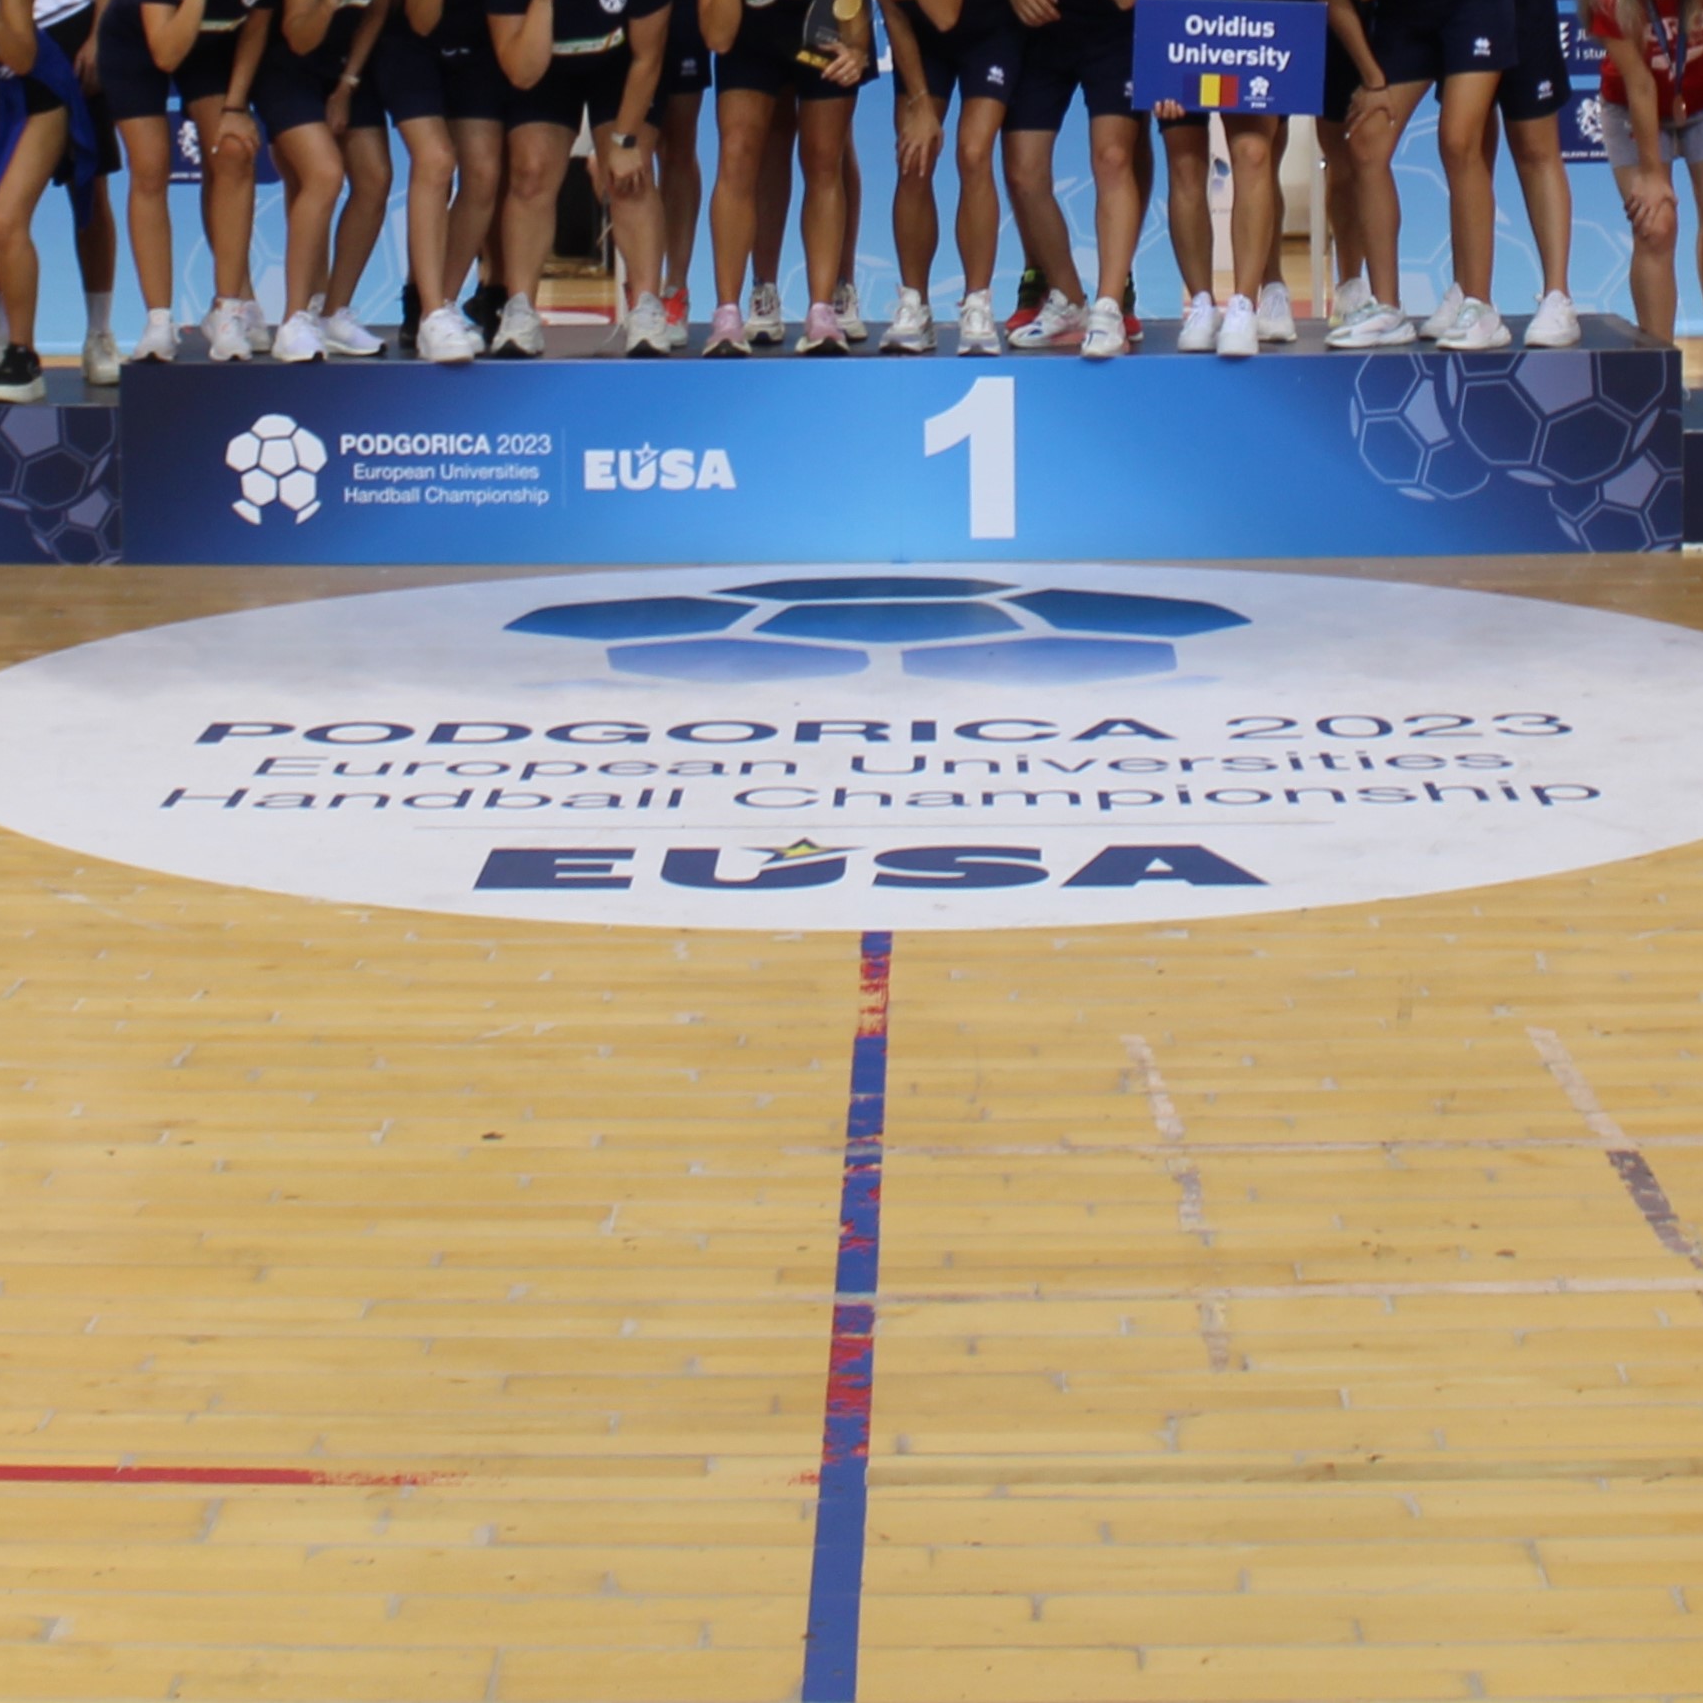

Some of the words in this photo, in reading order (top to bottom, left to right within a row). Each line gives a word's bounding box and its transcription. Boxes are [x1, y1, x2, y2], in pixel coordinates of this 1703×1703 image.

[1184, 14, 1275, 38] Ovidius
[1167, 42, 1291, 72] University
[340, 433, 492, 456] PODGORICA
[496, 433, 552, 455] 2023
[924, 376, 1016, 539] 1
[353, 463, 435, 482] European
[439, 462, 540, 480] Universities
[583, 441, 737, 491] EUSA
[343, 487, 420, 504] Handball
[424, 486, 550, 507] Championship
[195, 718, 1178, 745] PODGORICA
[1225, 713, 1574, 741] 2023
[253, 755, 800, 781] European
[849, 749, 1515, 776] Universities
[159, 786, 686, 810] Handball
[732, 780, 1603, 812] Championship
[473, 836, 1272, 891] EUSA
